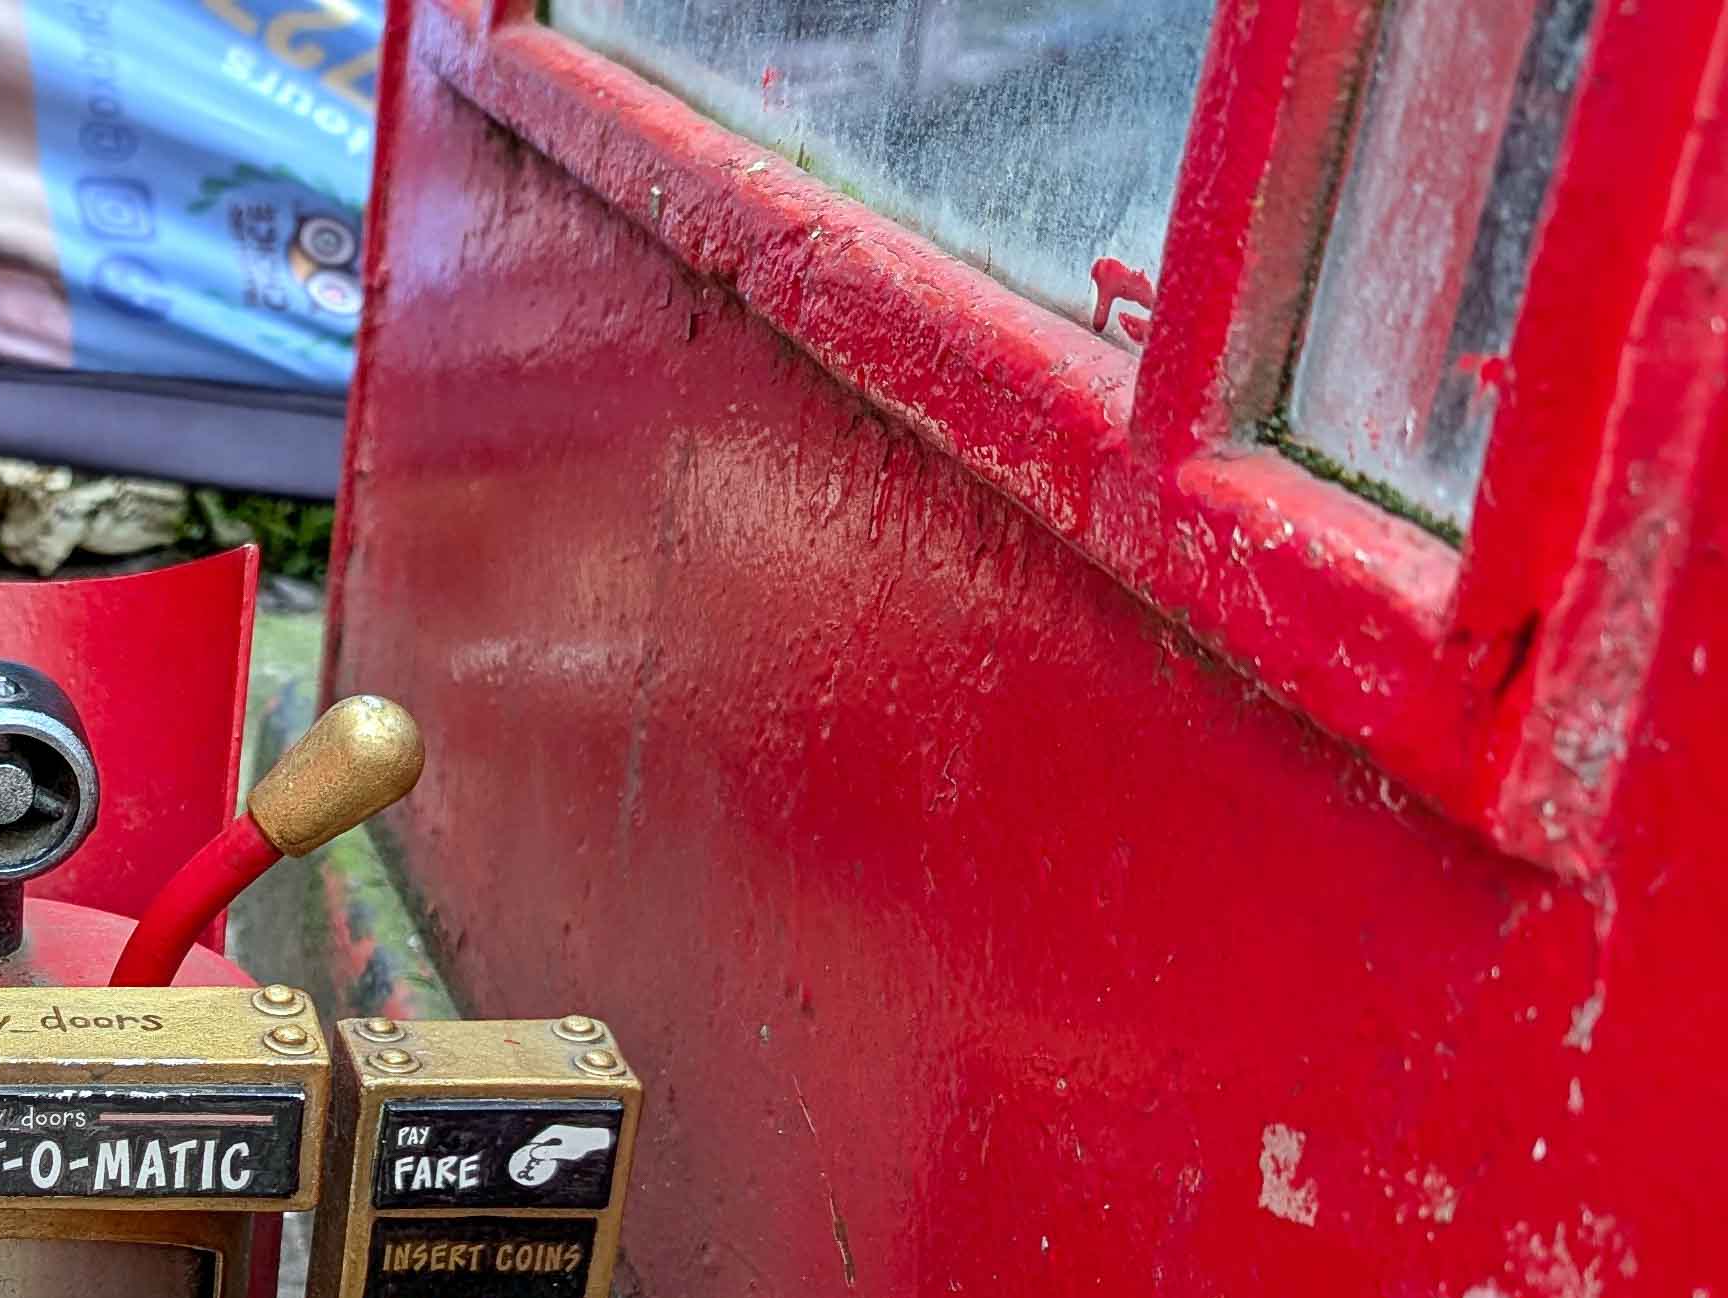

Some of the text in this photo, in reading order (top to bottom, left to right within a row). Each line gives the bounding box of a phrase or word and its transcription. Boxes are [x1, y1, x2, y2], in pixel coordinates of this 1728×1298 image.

[397, 1126, 430, 1146] PAY
[394, 1153, 480, 1190] FARE
[383, 1243, 584, 1272] INSERT COINS
